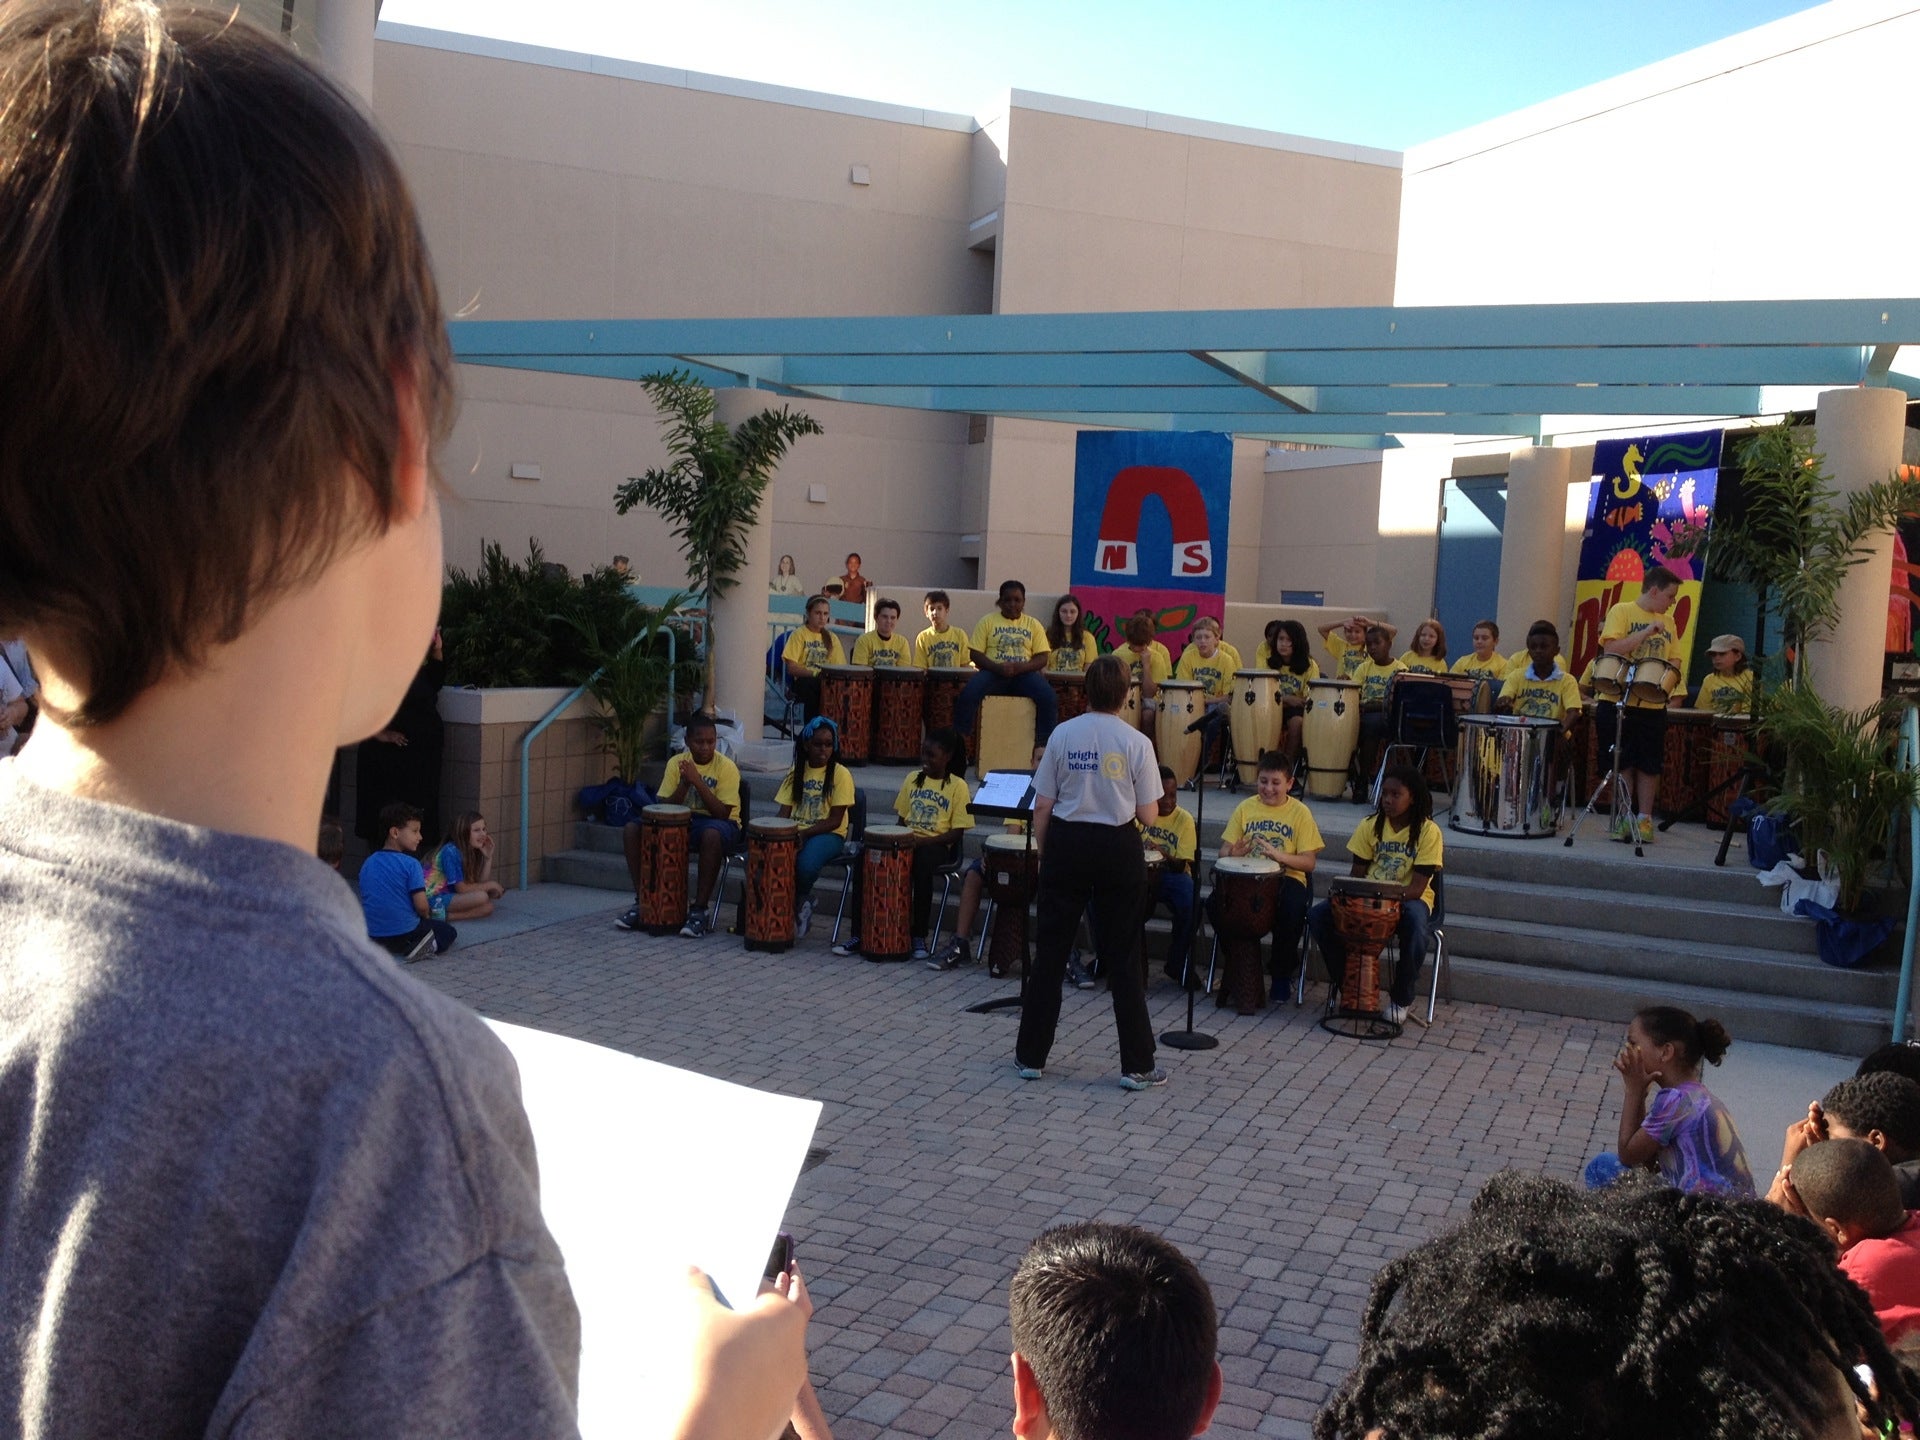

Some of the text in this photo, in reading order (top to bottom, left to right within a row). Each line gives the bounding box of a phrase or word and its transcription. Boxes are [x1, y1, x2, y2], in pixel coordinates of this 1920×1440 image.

[1102, 545, 1127, 570] N
[1182, 544, 1209, 573] S
[993, 627, 1032, 640] JAMERSON
[1517, 688, 1559, 705] JAMERSON
[1067, 751, 1099, 761] bright
[1068, 761, 1099, 771] house
[910, 789, 950, 812] JAMERSON
[1244, 820, 1293, 841] JAMERSON
